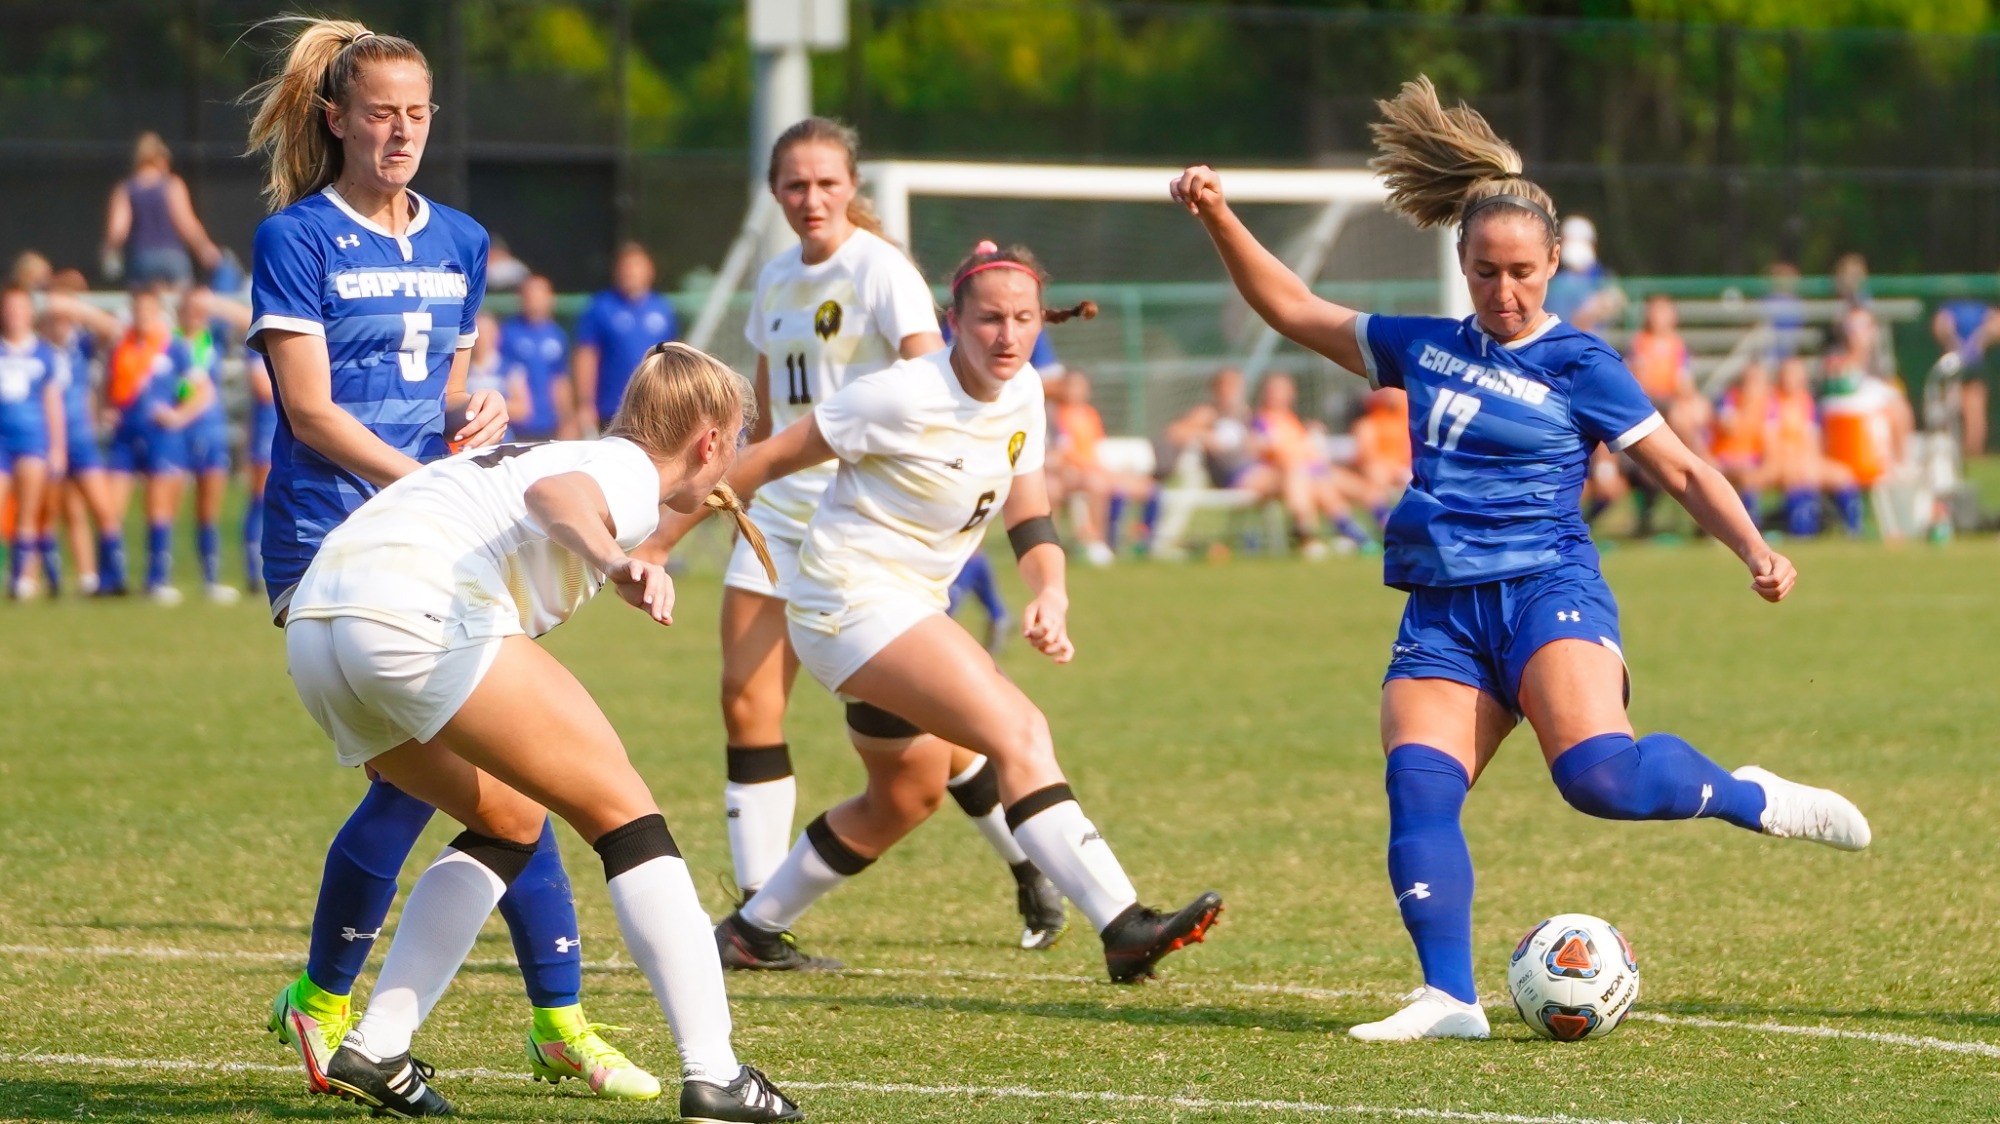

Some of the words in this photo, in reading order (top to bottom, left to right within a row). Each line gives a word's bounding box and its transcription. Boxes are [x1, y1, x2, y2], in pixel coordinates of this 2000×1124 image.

[398, 312, 432, 382] 5
[785, 352, 813, 405] 11
[1418, 344, 1550, 405] CAPTAINS
[1424, 387, 1481, 451] 17
[960, 491, 996, 533] 6
[1600, 972, 1624, 1004] NCAA
[1606, 983, 1635, 1018] Wilson
